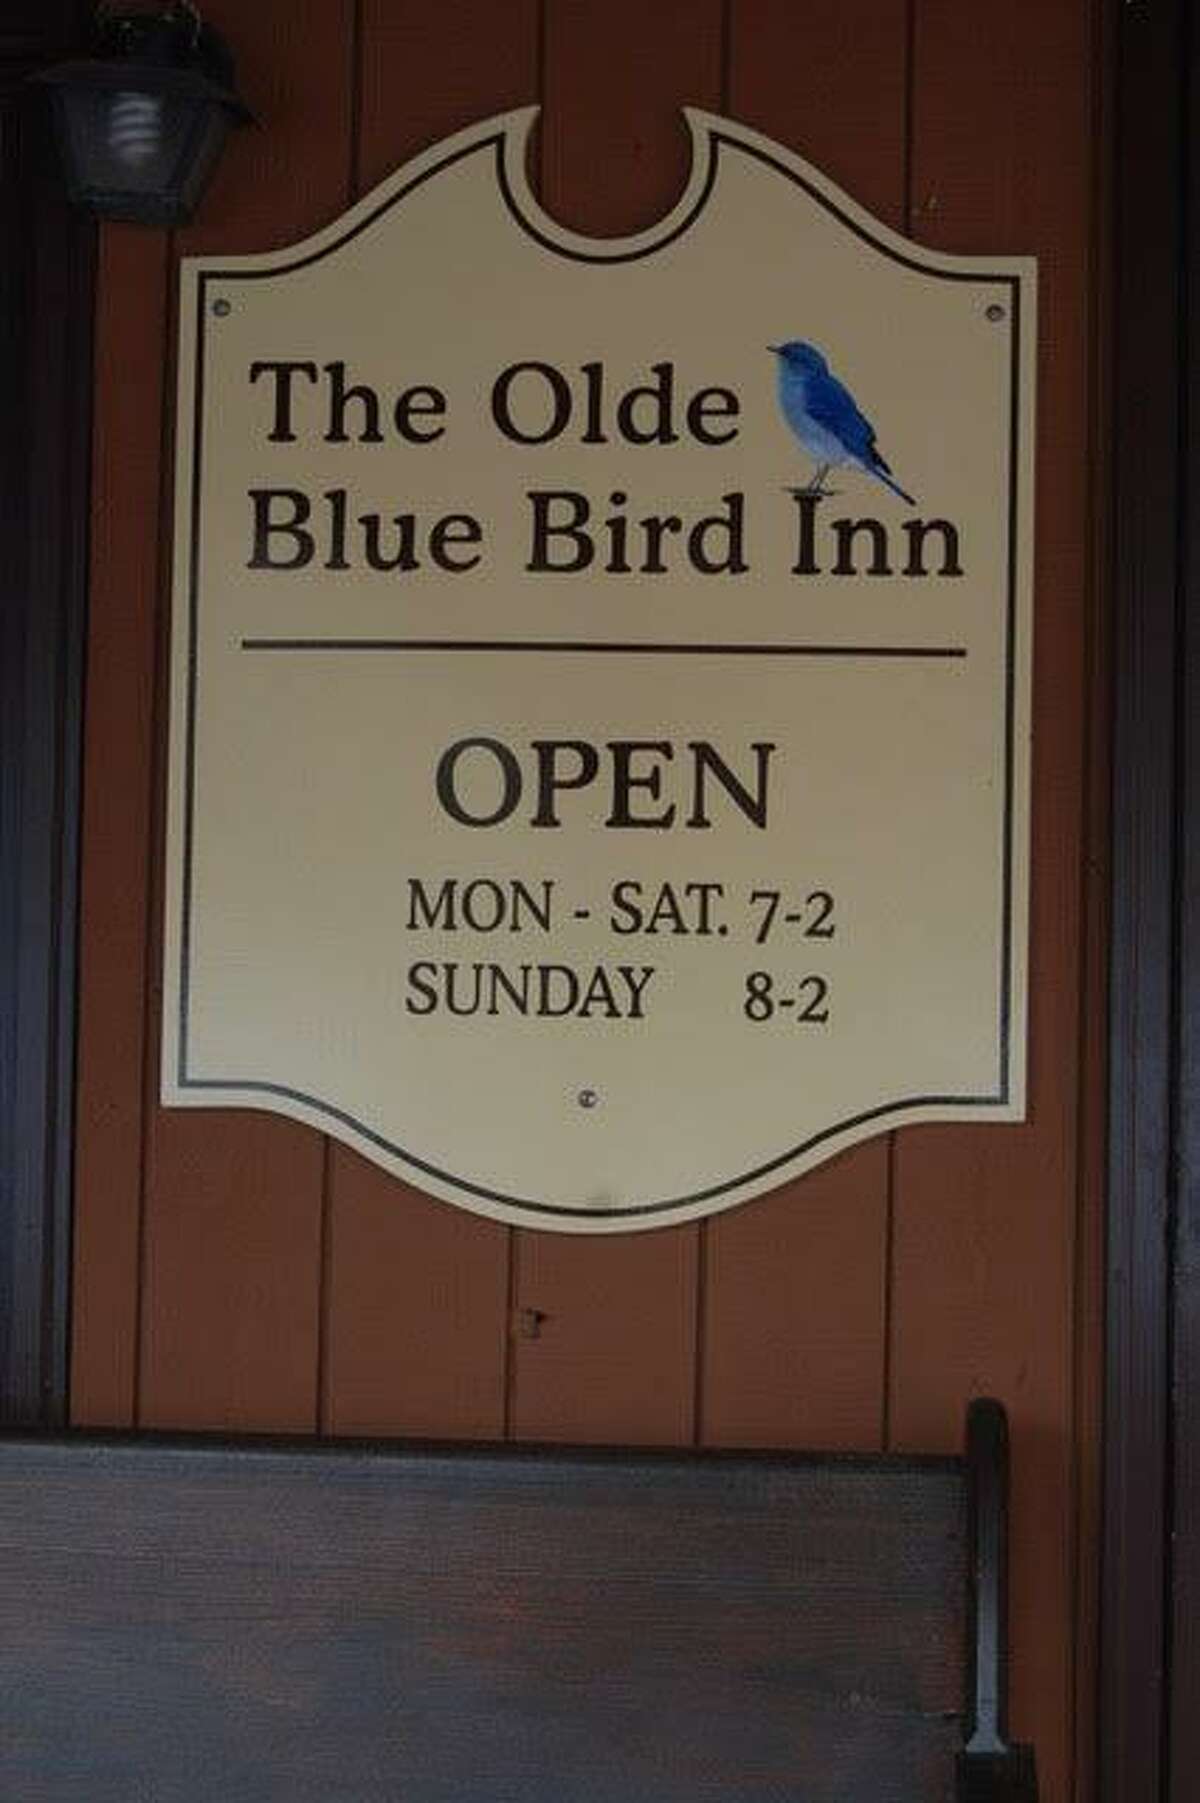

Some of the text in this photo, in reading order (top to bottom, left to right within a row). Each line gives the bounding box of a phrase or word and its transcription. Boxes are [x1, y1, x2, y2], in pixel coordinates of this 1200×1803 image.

[248, 359, 741, 447] The Olde
[245, 487, 965, 578] Blue Bird Inn
[435, 737, 777, 830] OPEN
[405, 878, 555, 933] MON
[610, 880, 728, 937] SAT.
[749, 890, 836, 945] 7-2
[405, 961, 830, 1024] SUNDAY 8-2
